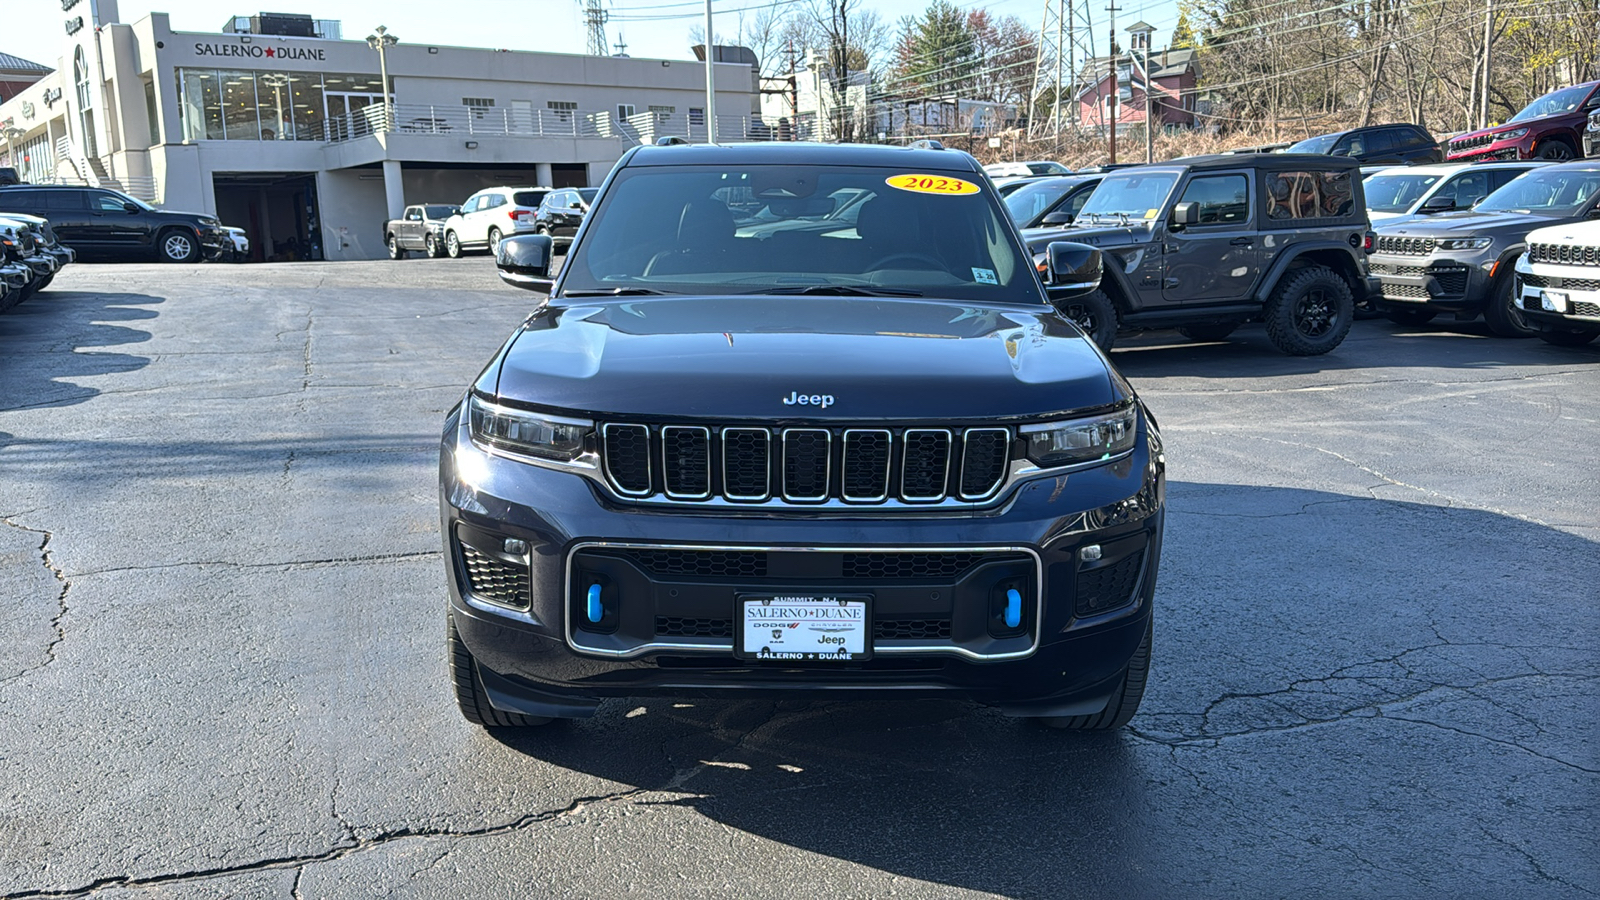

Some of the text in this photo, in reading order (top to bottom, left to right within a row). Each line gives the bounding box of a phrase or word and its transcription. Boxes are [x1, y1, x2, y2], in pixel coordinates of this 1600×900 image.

[195, 43, 326, 60] SALERNO DUANE
[903, 177, 963, 192] 2023
[783, 391, 835, 409] Jeep
[747, 607, 861, 619] SALERNO DUANE
[817, 635, 846, 646] Jeep
[756, 652, 803, 660] SALERNO
